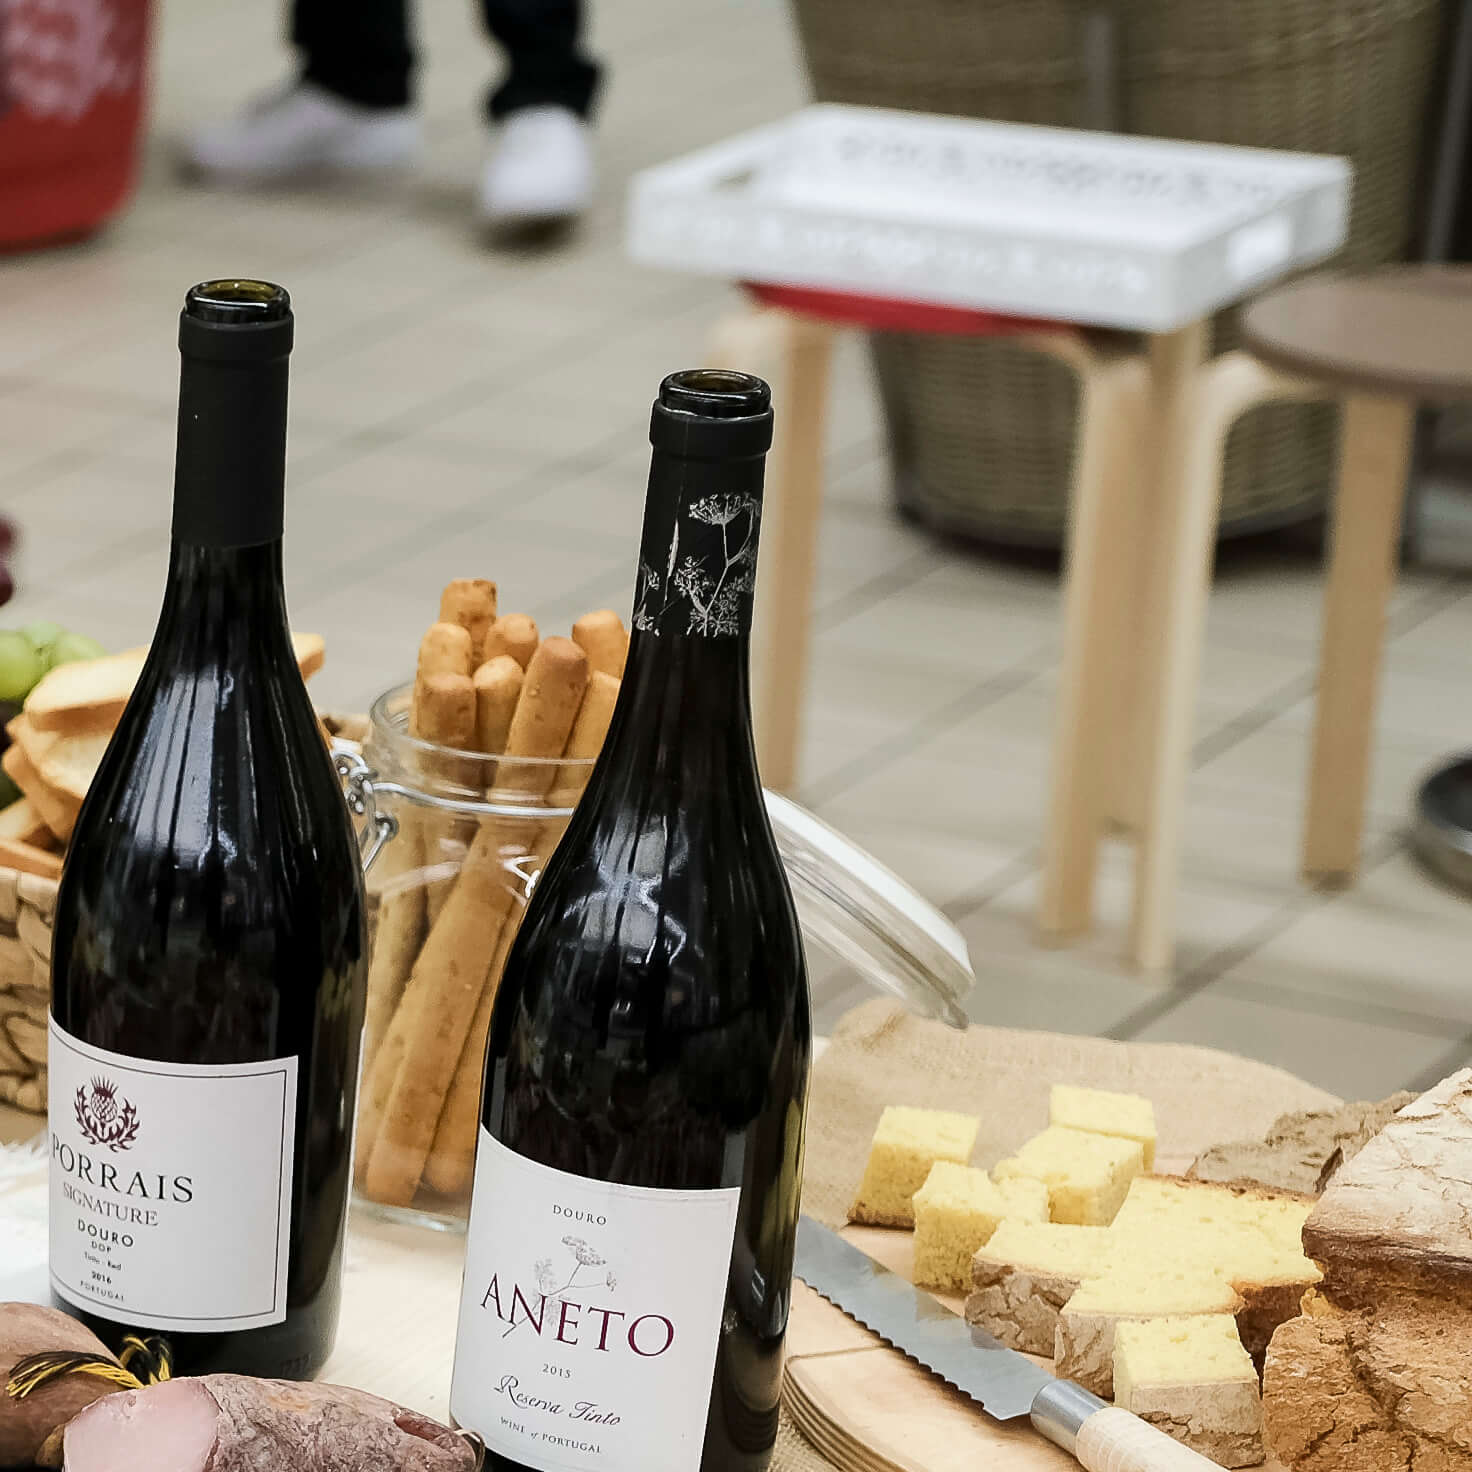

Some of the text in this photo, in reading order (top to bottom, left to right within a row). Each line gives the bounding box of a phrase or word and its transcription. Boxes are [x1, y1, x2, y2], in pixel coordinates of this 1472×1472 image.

[52, 1132, 194, 1203] PORRAIS
[63, 1181, 159, 1227] SIGNATURE
[553, 1204, 608, 1226] DOURO
[77, 1218, 134, 1248] DOURO
[480, 1272, 675, 1357] ANETO
[542, 1363, 572, 1379] 2015
[493, 1374, 622, 1426] Reserva Tinto
[499, 1416, 525, 1434] WINE
[542, 1433, 602, 1454] PORTUGAL
